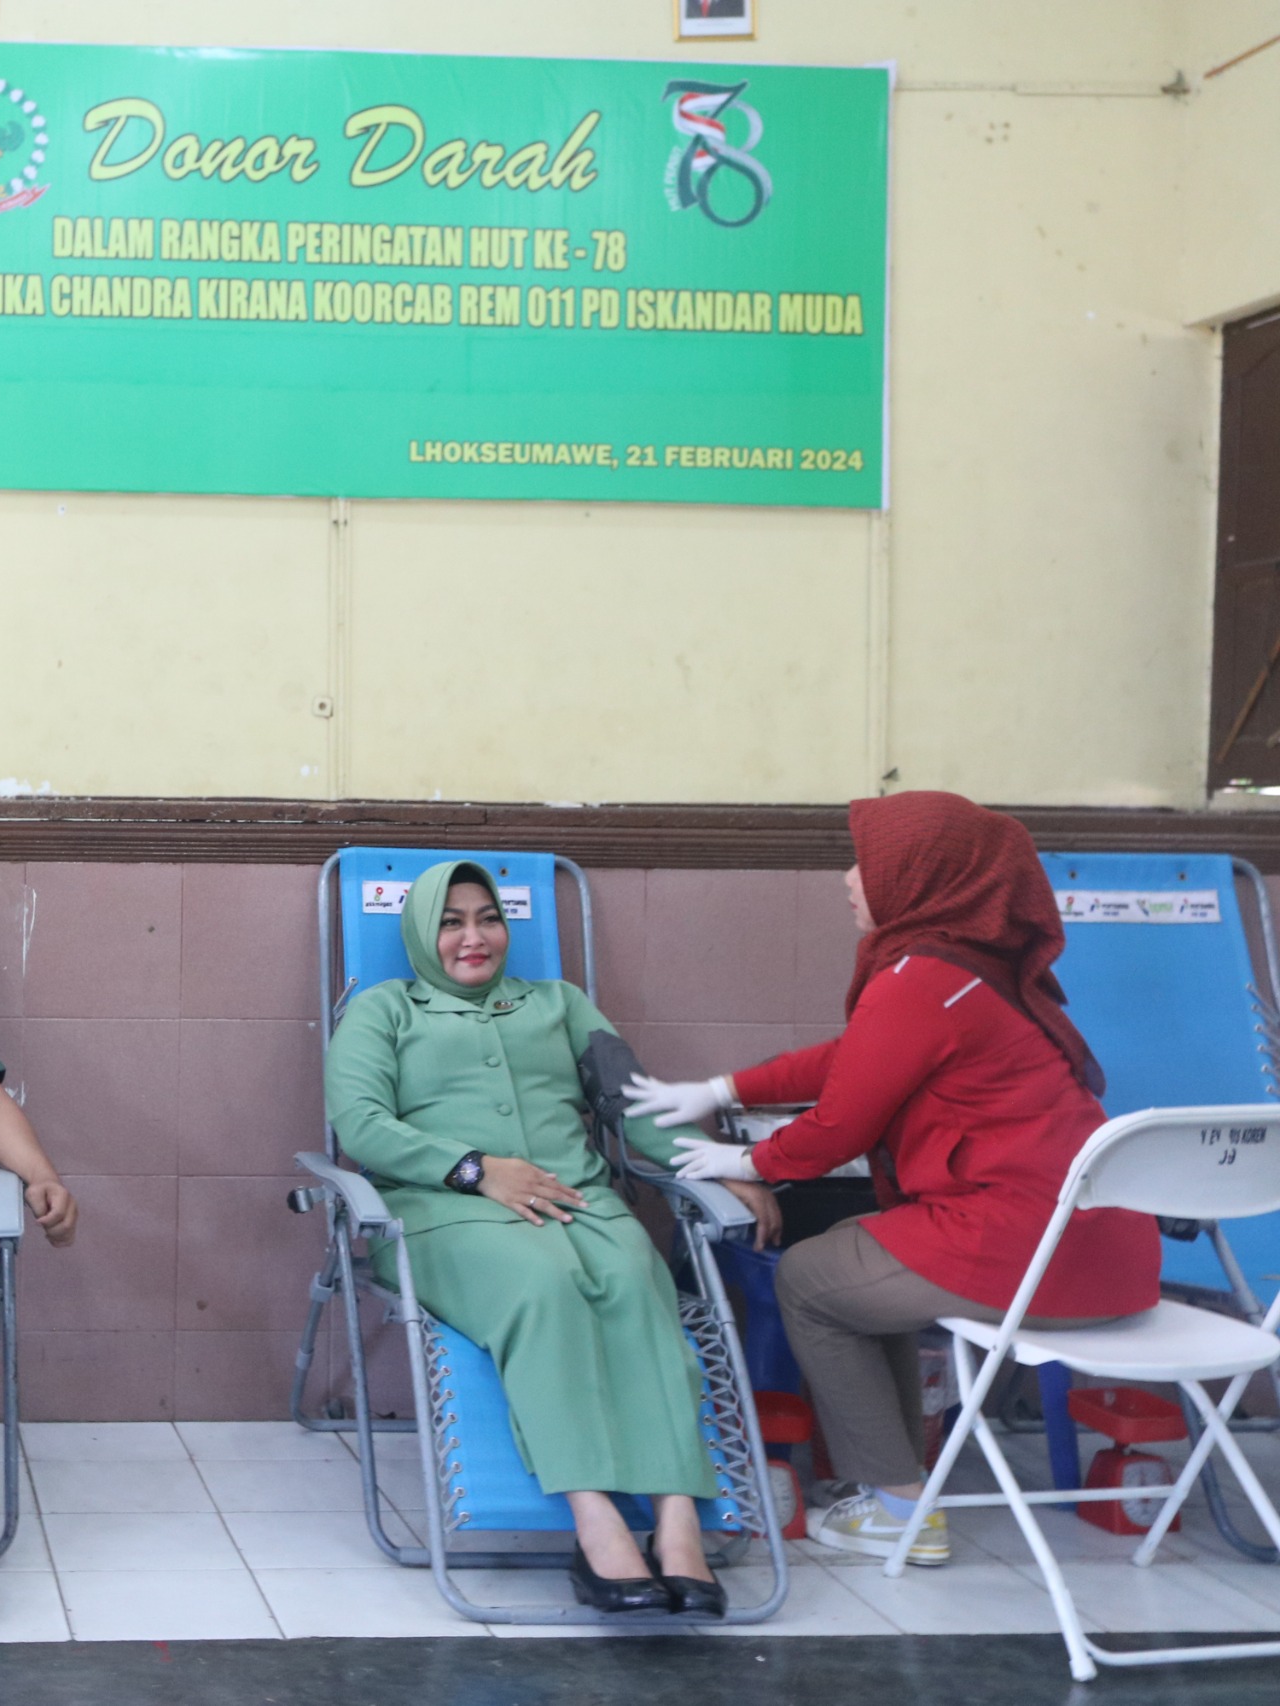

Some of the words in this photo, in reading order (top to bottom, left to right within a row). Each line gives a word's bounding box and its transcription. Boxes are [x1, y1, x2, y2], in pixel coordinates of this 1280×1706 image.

[83, 97, 318, 183] Donor
[343, 104, 601, 193] Darah
[53, 217, 154, 260] DALAM
[161, 219, 281, 263] RANGKA
[287, 222, 462, 268] PERINGATAN
[469, 228, 527, 270] HUT
[533, 230, 570, 270] KE
[592, 230, 627, 272] 78
[50, 275, 193, 320] CHANDRA
[198, 279, 307, 322] KIRANA
[313, 280, 453, 326] KOORCAB
[459, 284, 521, 328] REM
[526, 286, 577, 329] 011
[581, 287, 620, 331] PD
[626, 289, 773, 333] ISKANDAR
[777, 292, 865, 337] MUDA
[409, 440, 618, 470] LHOKSEUMAWE,
[625, 445, 658, 467] 21
[664, 446, 795, 470] FEBRUARI
[800, 449, 864, 472] 2024
